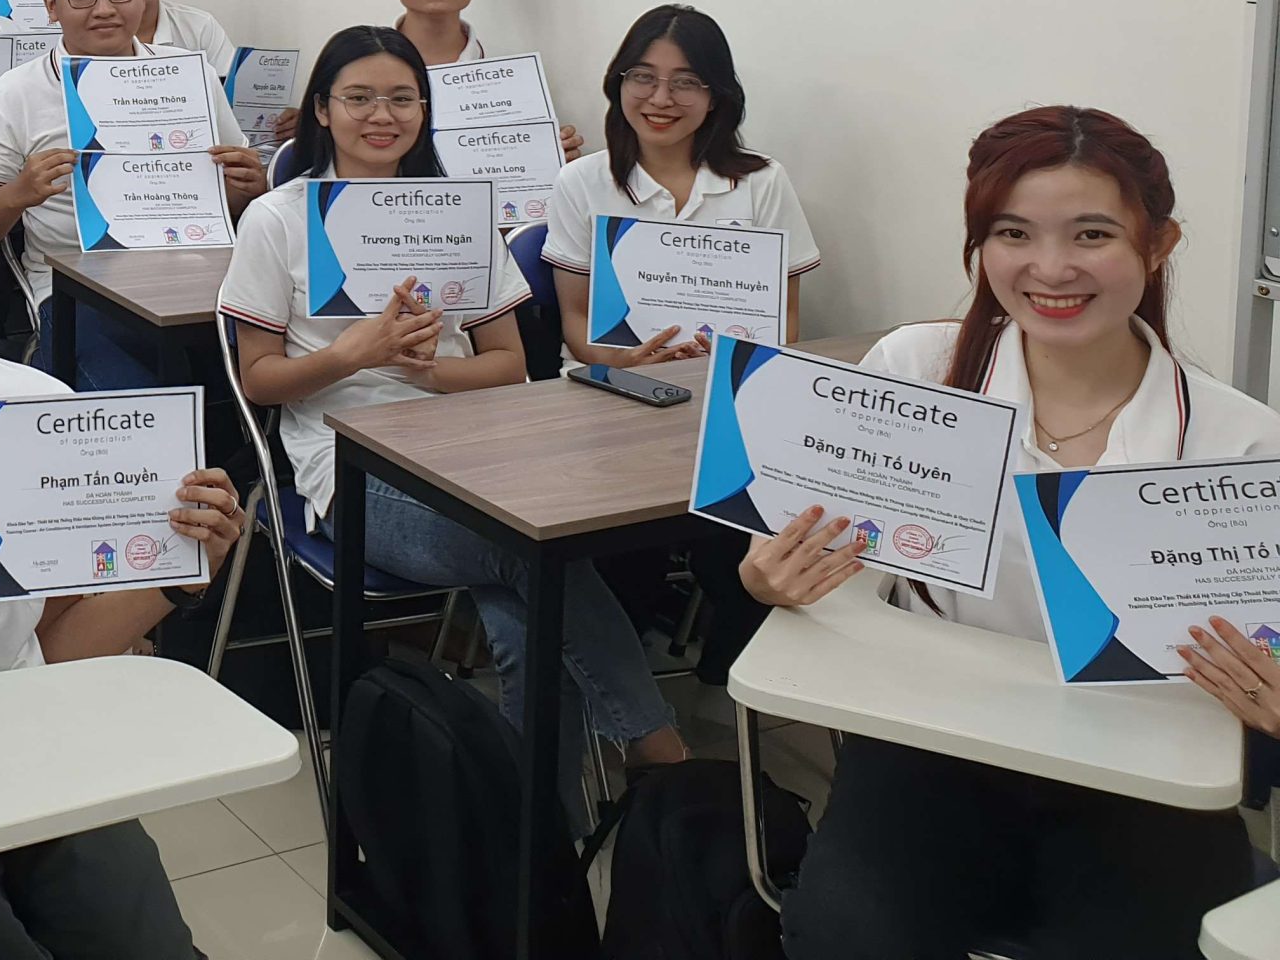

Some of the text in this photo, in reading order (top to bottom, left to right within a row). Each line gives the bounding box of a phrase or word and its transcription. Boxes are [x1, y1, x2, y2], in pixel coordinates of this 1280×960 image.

[110, 64, 179, 78] Certificate
[442, 67, 514, 86] Certificate
[161, 95, 187, 105] Thông
[490, 99, 512, 109] Long
[458, 131, 531, 147] Certificate
[122, 159, 193, 173] Certificate
[503, 165, 526, 174] Long
[372, 190, 462, 207] Certificate
[403, 234, 420, 246] Thị
[422, 234, 443, 244] Kim
[446, 234, 472, 246] Ngân
[660, 231, 751, 254] Certificate
[638, 271, 769, 293] Nguyễn Thị Thanh Huyền
[813, 376, 958, 429] Certificate
[37, 408, 155, 435] Certificate
[851, 409, 924, 434] appreciation
[73, 435, 133, 446] appreciation
[803, 435, 952, 484] Đặng Thị Tố Uyên
[40, 467, 159, 491] Phạm Tấn Quyền
[843, 470, 941, 500] SUCCESSFULLY COMPLETED
[121, 495, 156, 503] COMPLETED
[1139, 475, 1280, 506] Certifica
[1150, 542, 1270, 566] Đặng Thị Tố
[1213, 574, 1276, 584] SUCCESSFULLY
